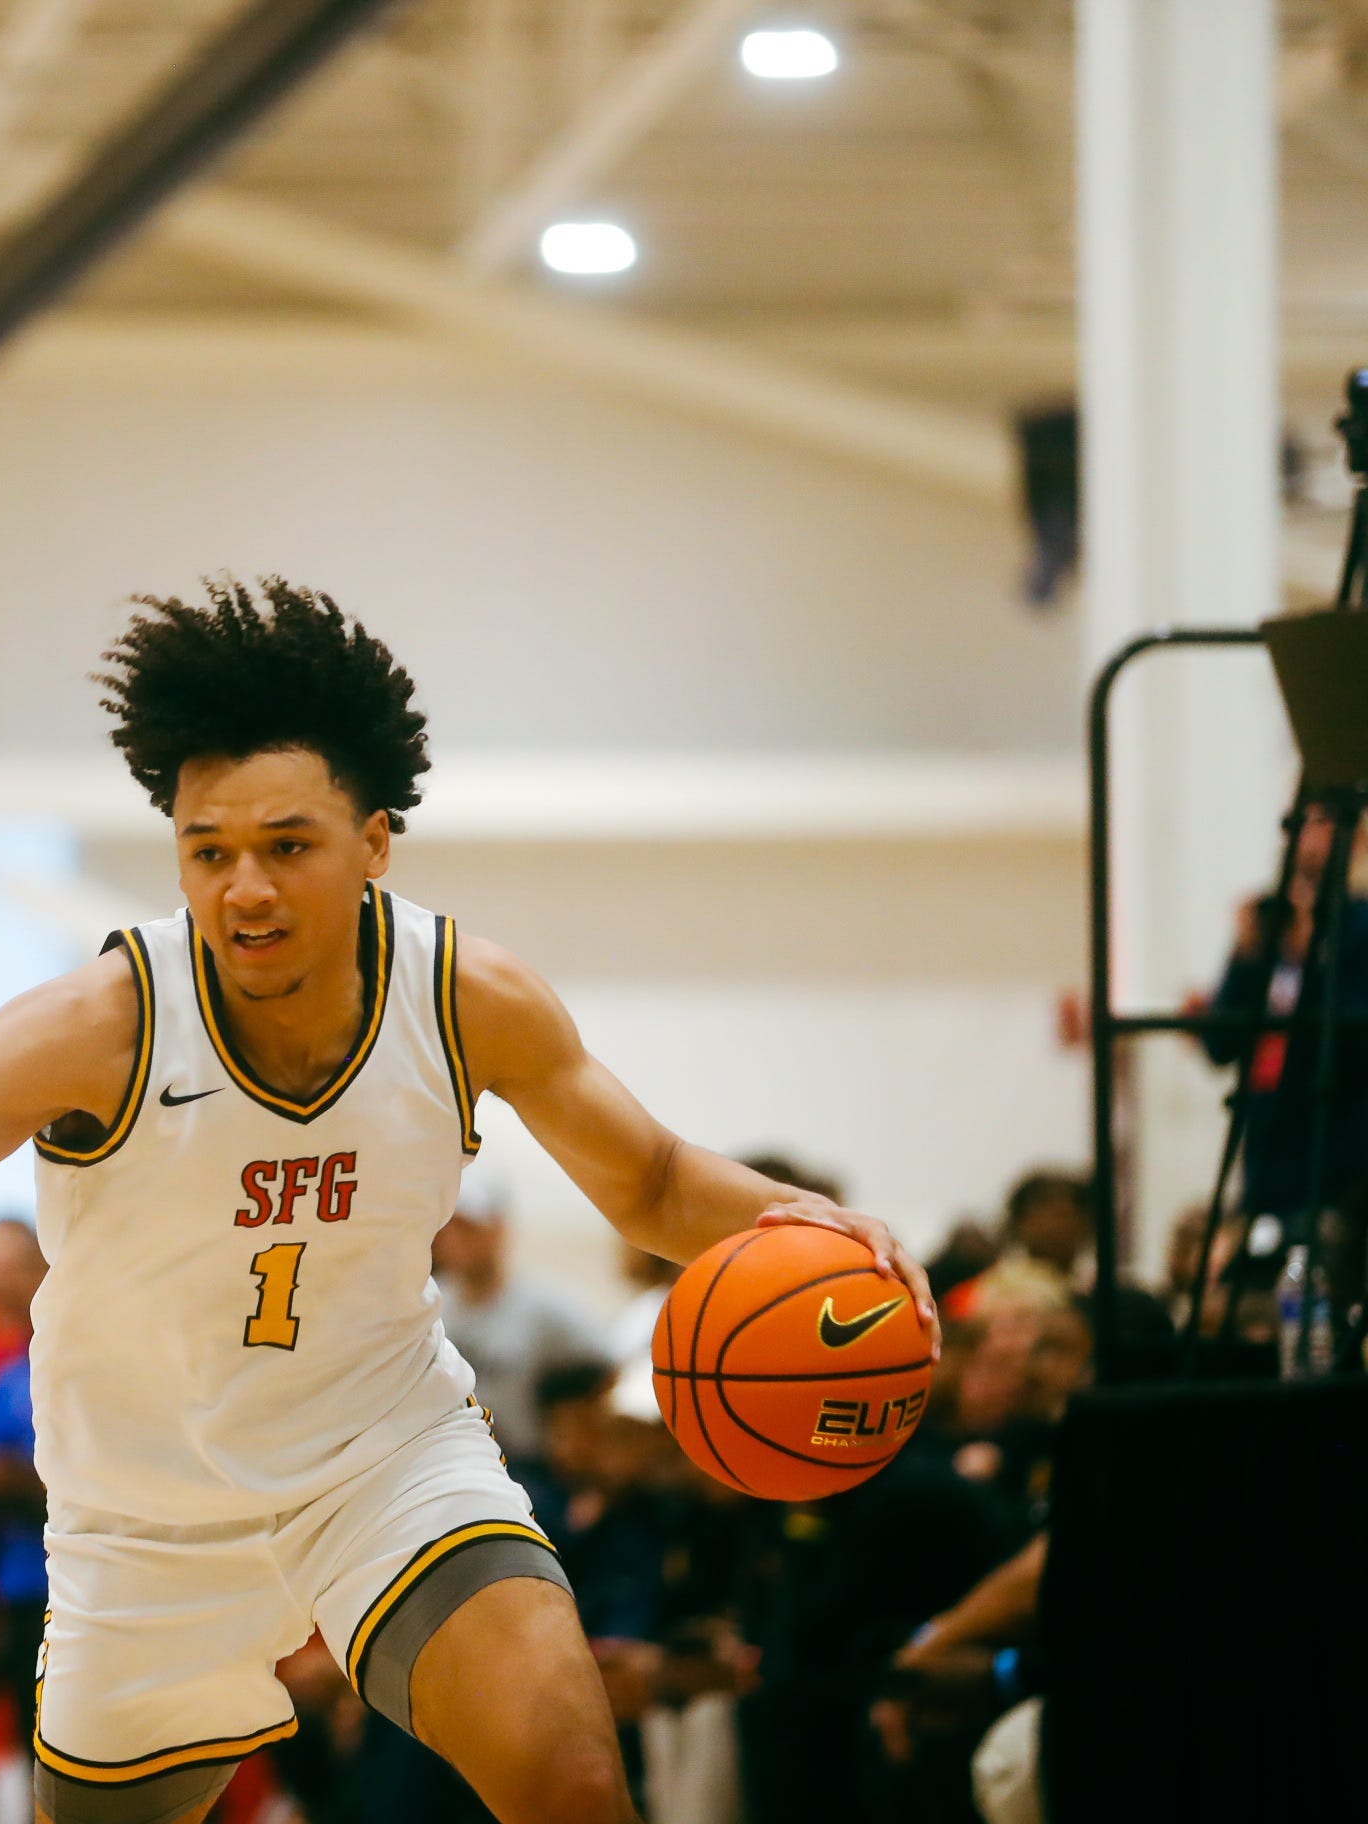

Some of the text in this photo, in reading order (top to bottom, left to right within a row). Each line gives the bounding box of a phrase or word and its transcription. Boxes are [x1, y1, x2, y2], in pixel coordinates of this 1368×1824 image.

[234, 1151, 358, 1228] SFG
[243, 1241, 307, 1351] 1
[814, 1386, 927, 1436] ELITE
